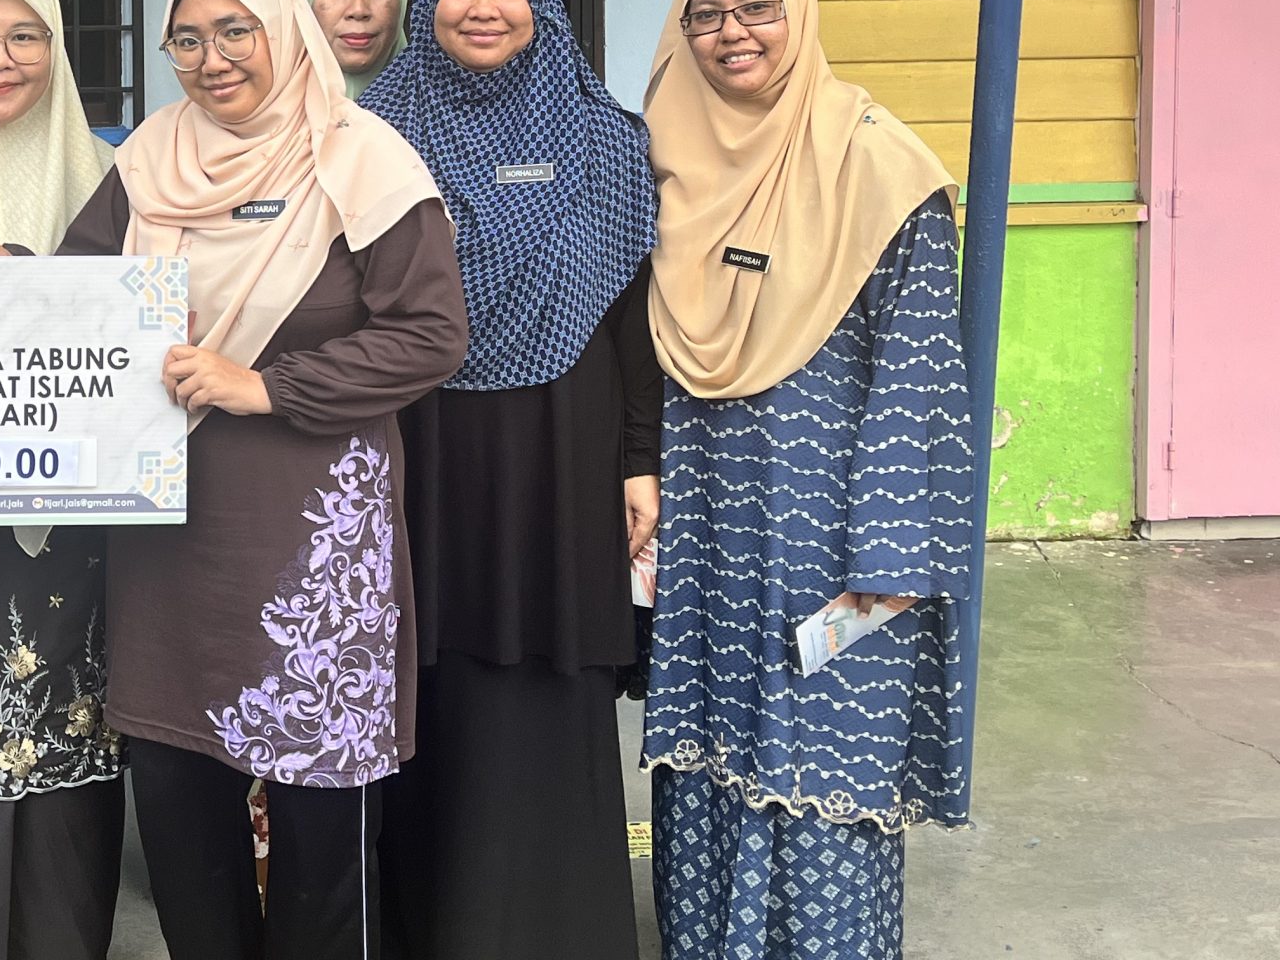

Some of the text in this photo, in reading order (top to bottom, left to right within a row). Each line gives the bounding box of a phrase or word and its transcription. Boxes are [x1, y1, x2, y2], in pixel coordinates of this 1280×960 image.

[505, 169, 544, 177] NORHALIZA
[254, 205, 278, 213] SARAH
[13, 347, 130, 370] TABUNG
[30, 375, 114, 398] ISLAM
